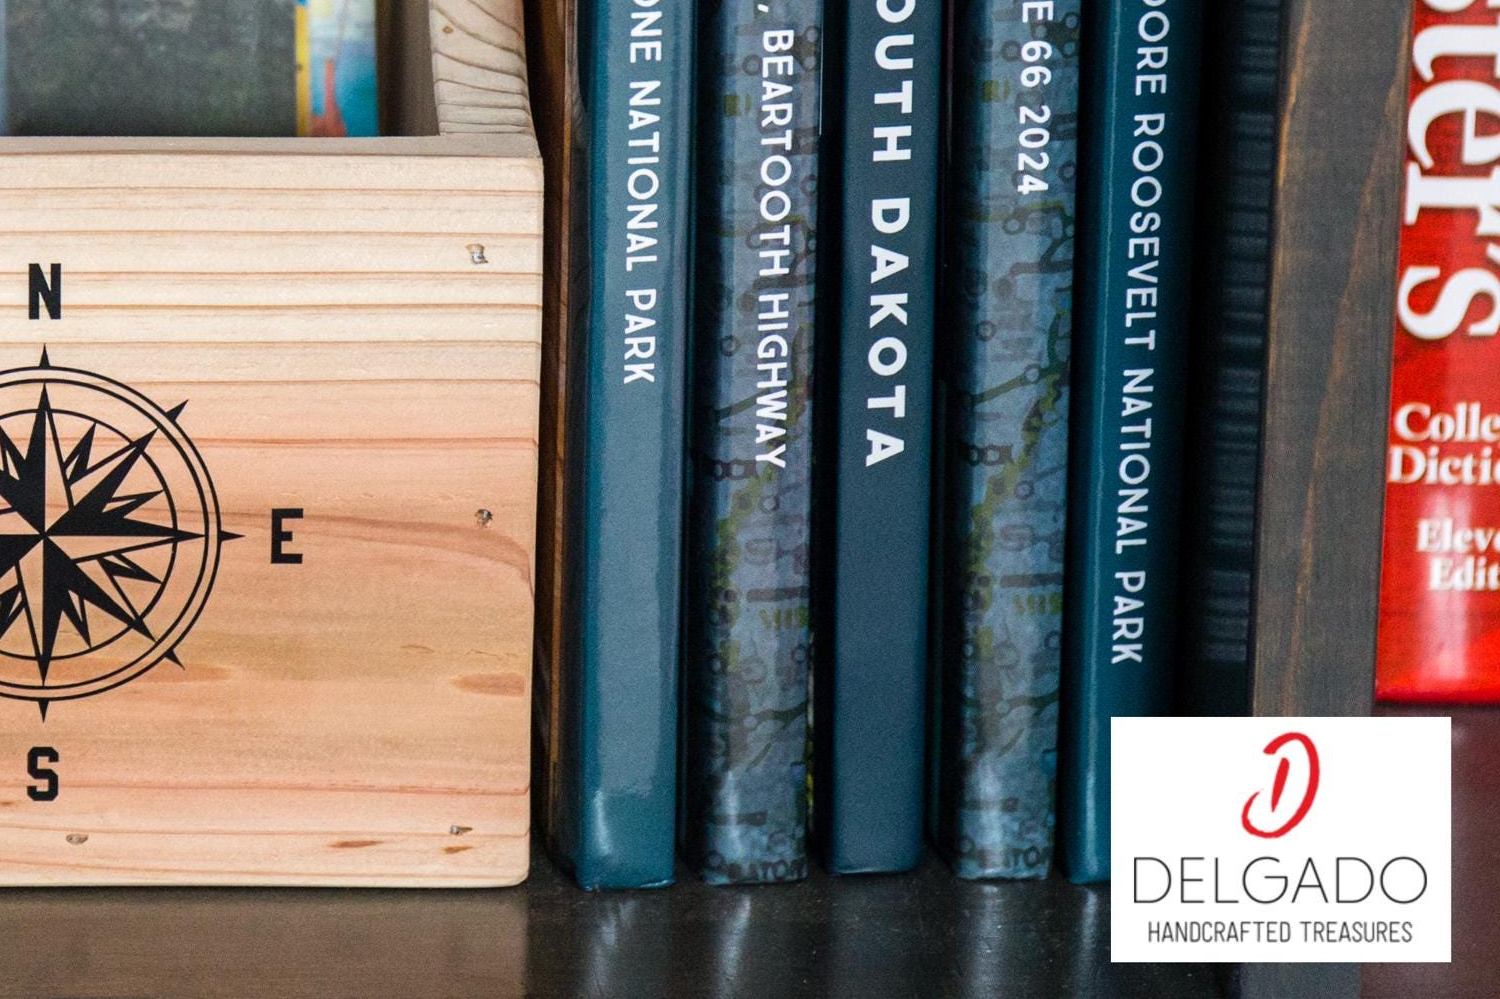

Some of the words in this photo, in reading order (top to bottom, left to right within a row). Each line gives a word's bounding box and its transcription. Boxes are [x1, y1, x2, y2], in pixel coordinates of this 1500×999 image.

[1019, 40, 1053, 88] 66
[625, 80, 661, 272] NATIONAL
[758, 29, 795, 277] BEARTOOTH
[1017, 105, 1051, 196] 2024
[1124, 113, 1165, 351] ROOSEVELT
[28, 262, 62, 321] N
[623, 288, 657, 384] PARK
[865, 197, 911, 467] DAKOTA
[754, 292, 789, 468] HIGHWAY
[1115, 368, 1154, 555] NATIONAL
[1387, 445, 1500, 485] Dicti
[270, 507, 305, 565] E
[1111, 570, 1146, 664] PARK
[26, 746, 60, 802] S
